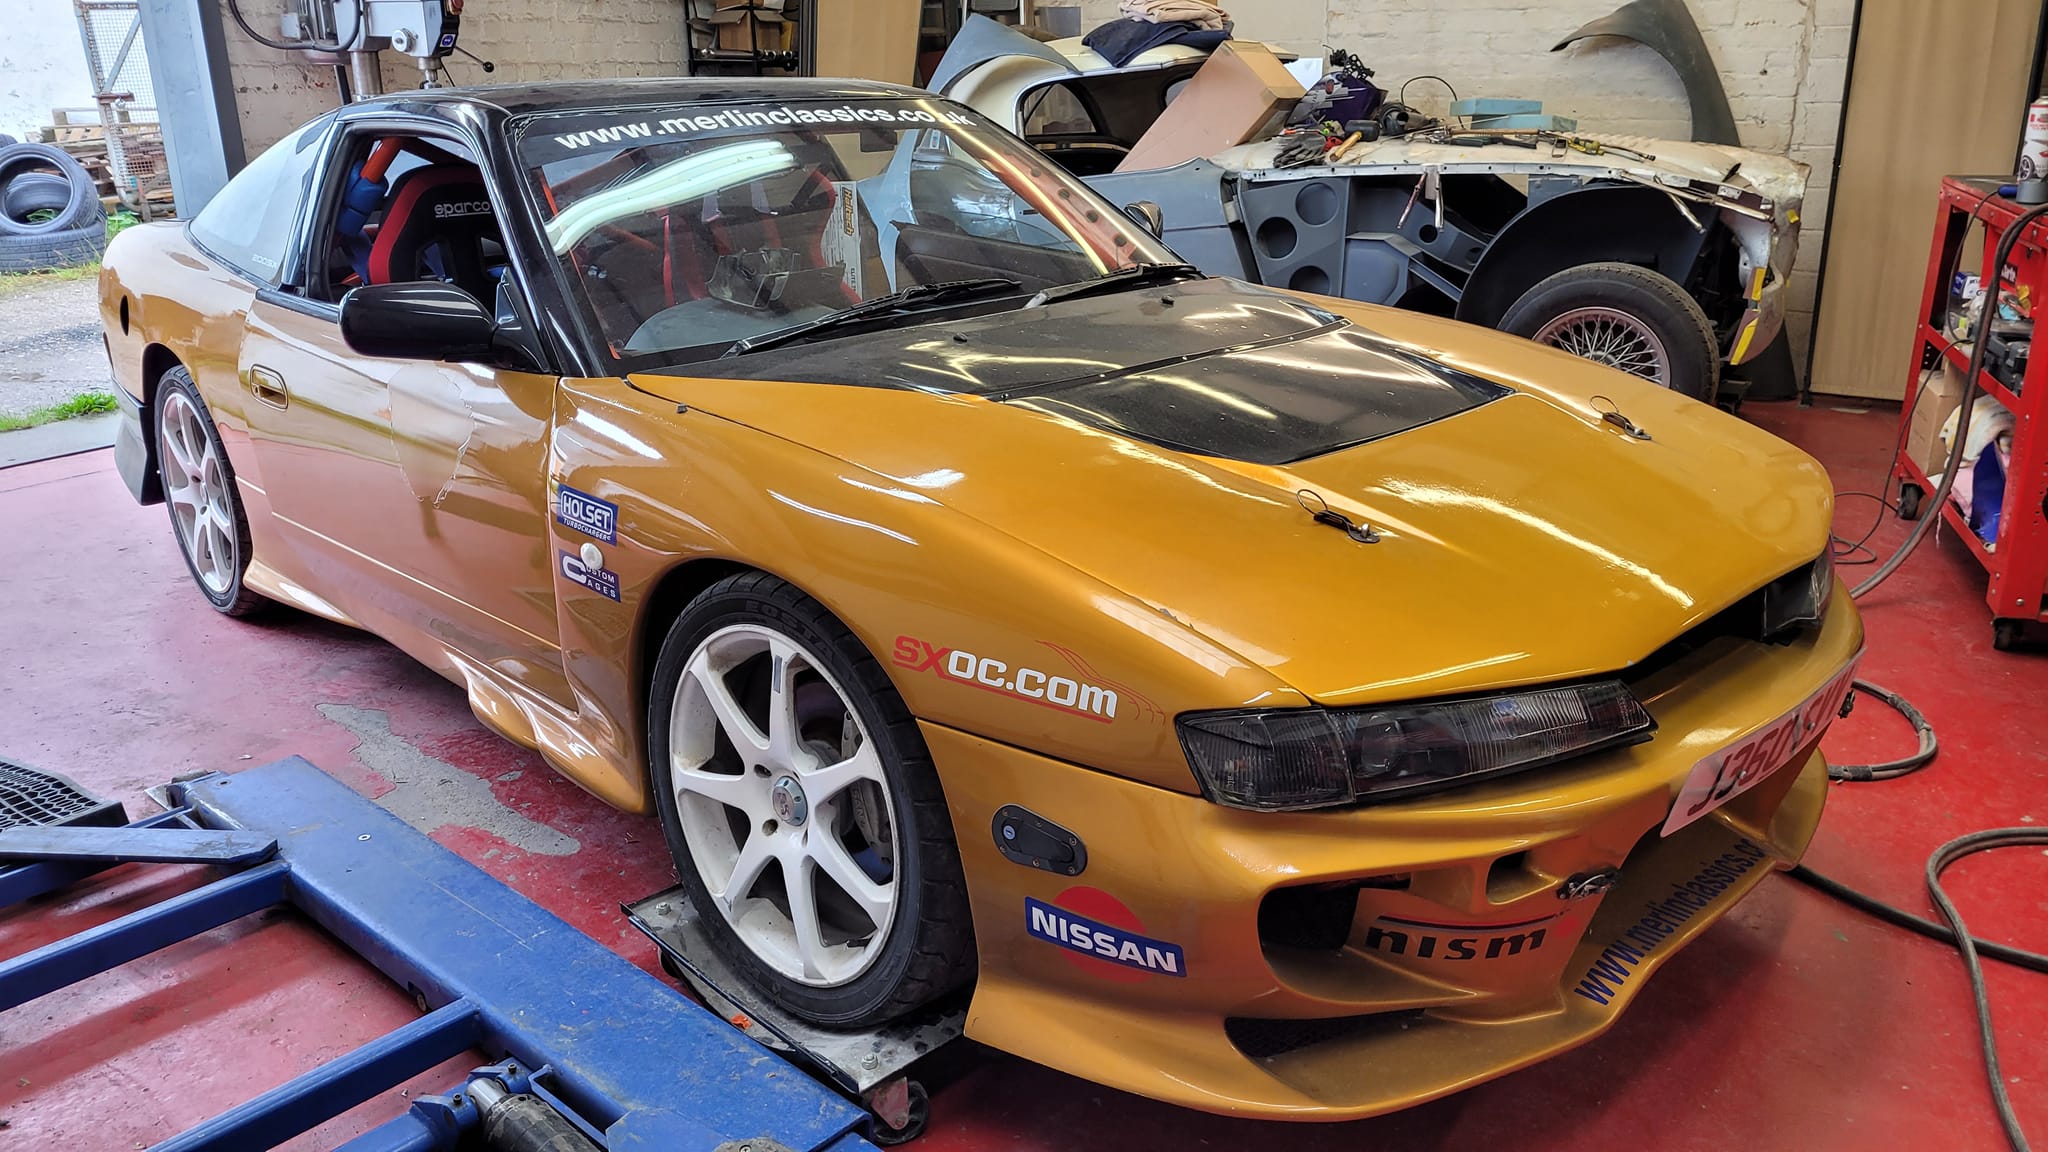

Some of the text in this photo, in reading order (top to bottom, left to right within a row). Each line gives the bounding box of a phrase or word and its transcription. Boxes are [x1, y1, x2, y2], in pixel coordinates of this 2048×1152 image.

[434, 201, 491, 218] sparco
[843, 187, 855, 236] Haltech
[563, 495, 610, 531] HOLSET
[1032, 906, 1178, 973] NISSAN
